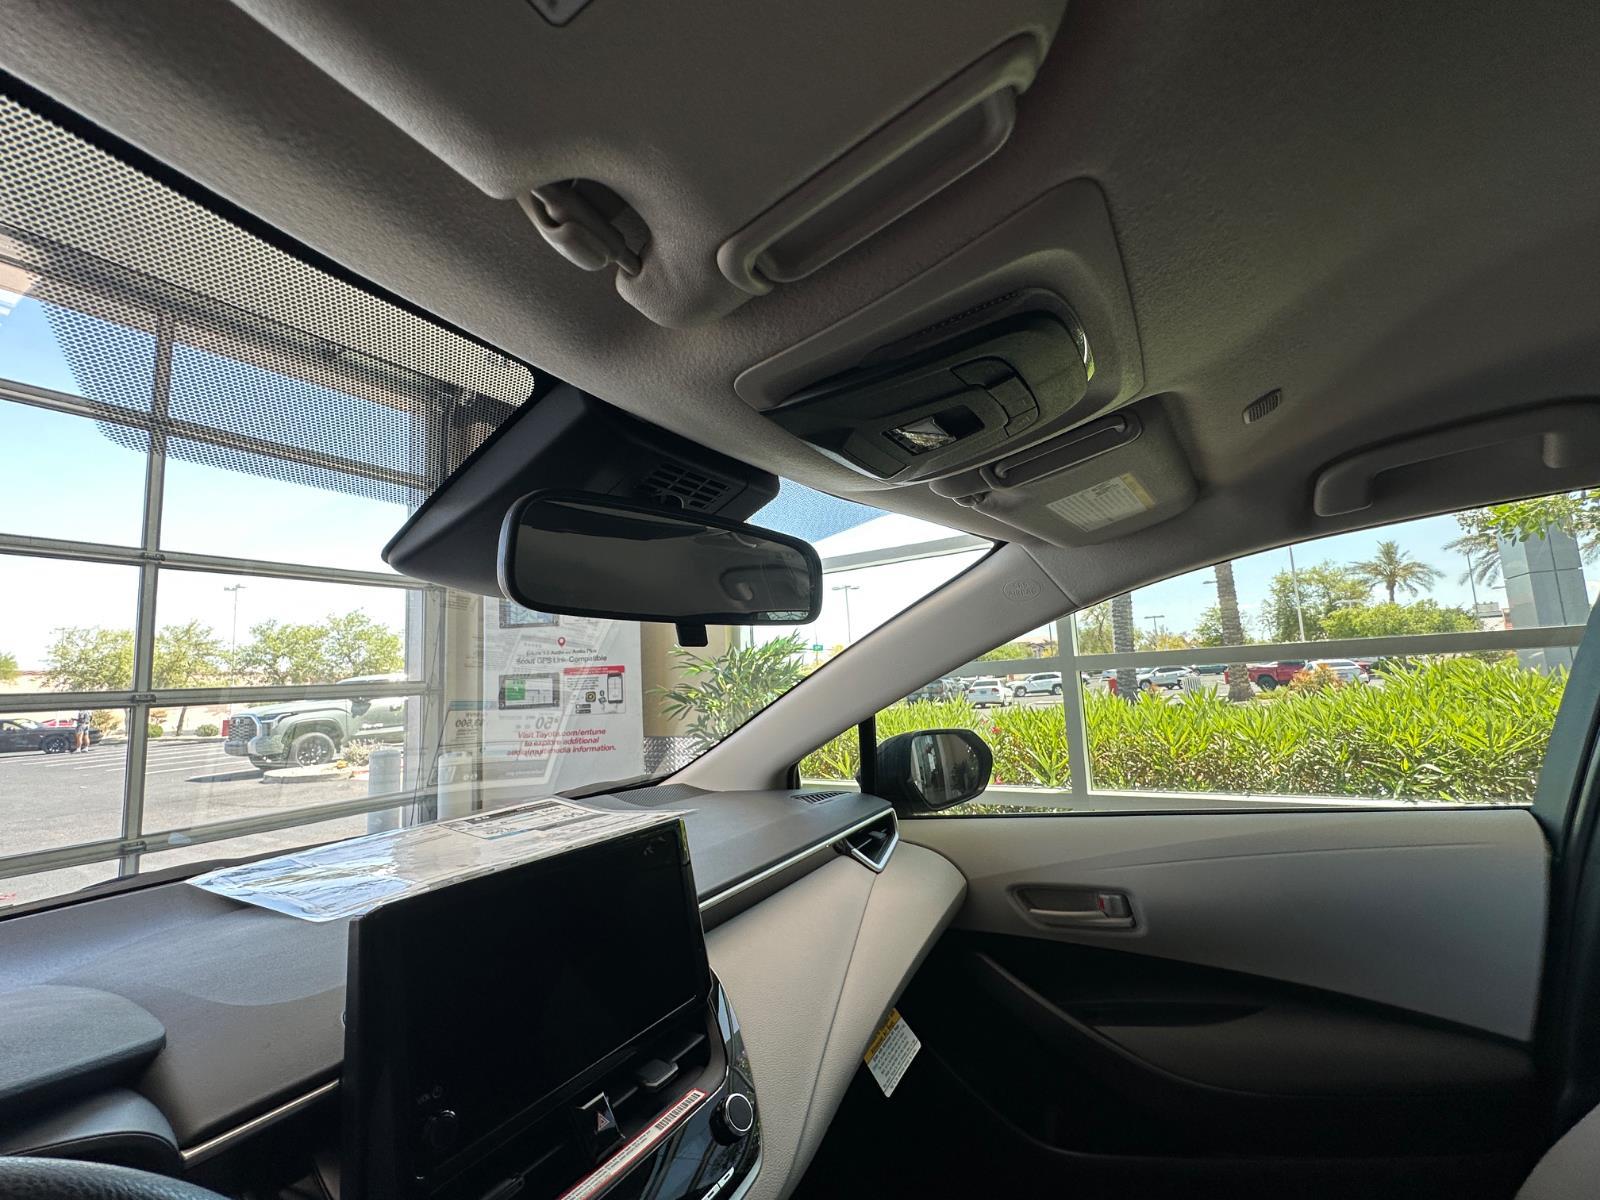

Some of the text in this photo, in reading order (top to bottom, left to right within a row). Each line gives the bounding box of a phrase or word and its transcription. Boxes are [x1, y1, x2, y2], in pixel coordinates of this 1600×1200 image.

[537, 656, 552, 664] GPS
[518, 730, 534, 738] Visit
[562, 736, 600, 745] additional
[572, 743, 617, 753] information.
